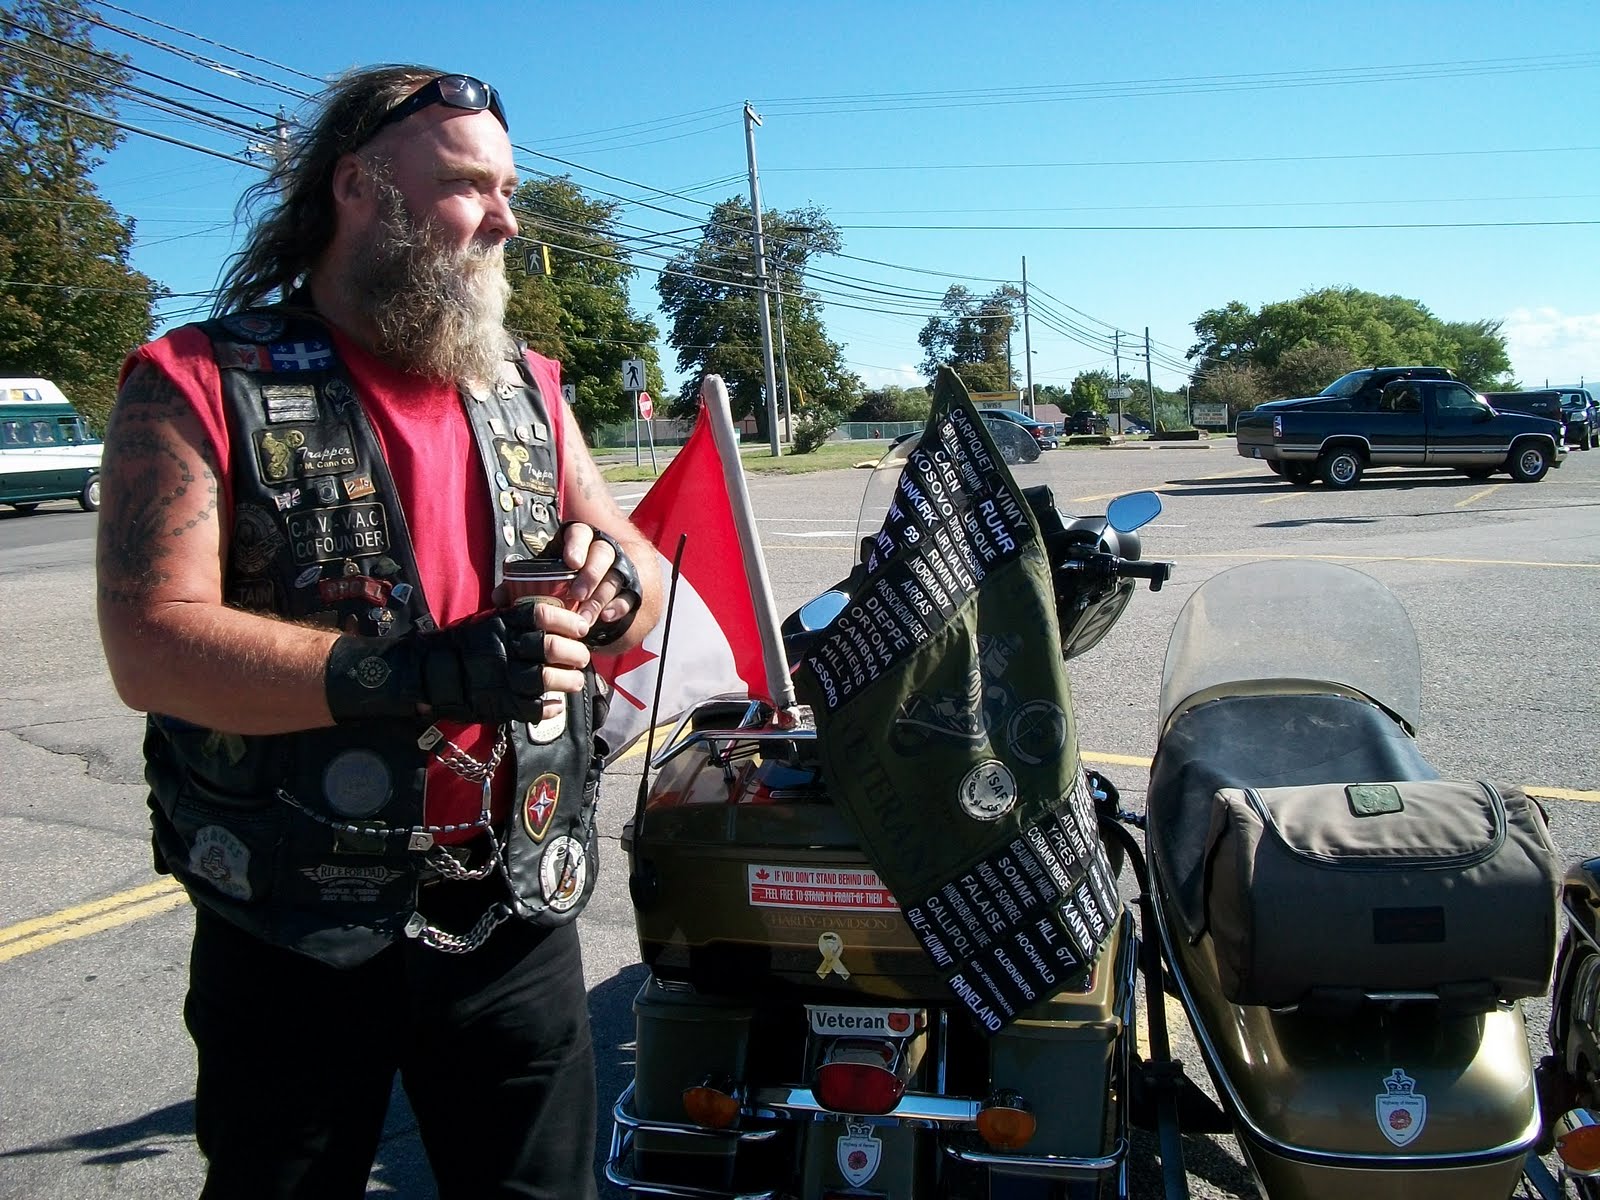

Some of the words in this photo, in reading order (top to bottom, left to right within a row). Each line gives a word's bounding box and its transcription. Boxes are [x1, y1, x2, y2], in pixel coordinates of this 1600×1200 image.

[297, 447, 351, 461] Trapper
[942, 422, 962, 453] BATTLE
[952, 408, 994, 472] CARPIQUET
[956, 450, 968, 462] OF
[911, 449, 953, 516] KOSOVO
[934, 450, 961, 493] CAEN
[961, 461, 984, 492] BRITAIN
[979, 500, 1015, 554] RUHR
[995, 485, 1028, 528] VIMY
[903, 525, 920, 543] 59
[934, 527, 951, 552] LIRI
[948, 550, 976, 592] VALLEY
[958, 538, 986, 580] CROSSING
[964, 510, 997, 562] UBIQUE
[900, 579, 933, 616] ARRAS
[910, 556, 951, 610] NORMANDY
[927, 549, 958, 594] RIMINI
[851, 606, 893, 667] ORTONA
[865, 597, 909, 650] DIEPPE
[875, 578, 929, 643] PASSCHENDAELE
[820, 645, 845, 678] HILL
[841, 676, 852, 695] 70
[830, 634, 865, 686] AMIENS
[837, 617, 881, 681] CAMBRAI
[808, 656, 838, 708] ASSORO
[986, 771, 1009, 800] ISAF
[1027, 826, 1056, 866] CORIANO
[1050, 862, 1072, 891] RIDGE
[1046, 823, 1075, 866] YPRES
[1061, 813, 1087, 858] ATLANTIC
[774, 870, 781, 882] IF
[781, 871, 794, 883] YOU
[795, 872, 814, 884] DON'T
[816, 873, 837, 885] STAND
[838, 873, 861, 886] BEHIND
[862, 874, 877, 886] OUR
[780, 889, 794, 901] FREE
[795, 890, 803, 901] TO
[804, 891, 824, 902] STAND
[825, 891, 833, 902] IN
[834, 892, 854, 904] FRONT
[855, 892, 864, 904] OF
[865, 893, 883, 905] THEM
[975, 861, 1003, 892] MOUNT
[995, 889, 1023, 925] SORREL
[998, 856, 1037, 909] SOMME
[1009, 839, 1043, 879] BEAUMONT
[1034, 876, 1057, 903] HAMEL
[770, 914, 887, 929] HARLEY-DAVIDSON
[926, 896, 975, 959] GALLIPOLI
[941, 882, 980, 931] HINDENBURG
[972, 927, 992, 948] LINE
[960, 875, 1006, 934] FALAISE
[1062, 900, 1093, 955] XANTEN
[1077, 882, 1105, 937] NIAGARA
[907, 907, 954, 967] GULF-KUWAIT
[1014, 931, 1056, 984] HOCHWALD
[1035, 918, 1057, 945] HILL
[1056, 946, 1077, 967] 677
[970, 960, 983, 973] BAD
[993, 948, 1036, 1000] OLDENBURG
[815, 1012, 885, 1030] Veteran
[948, 973, 1001, 1031] RHINELAND
